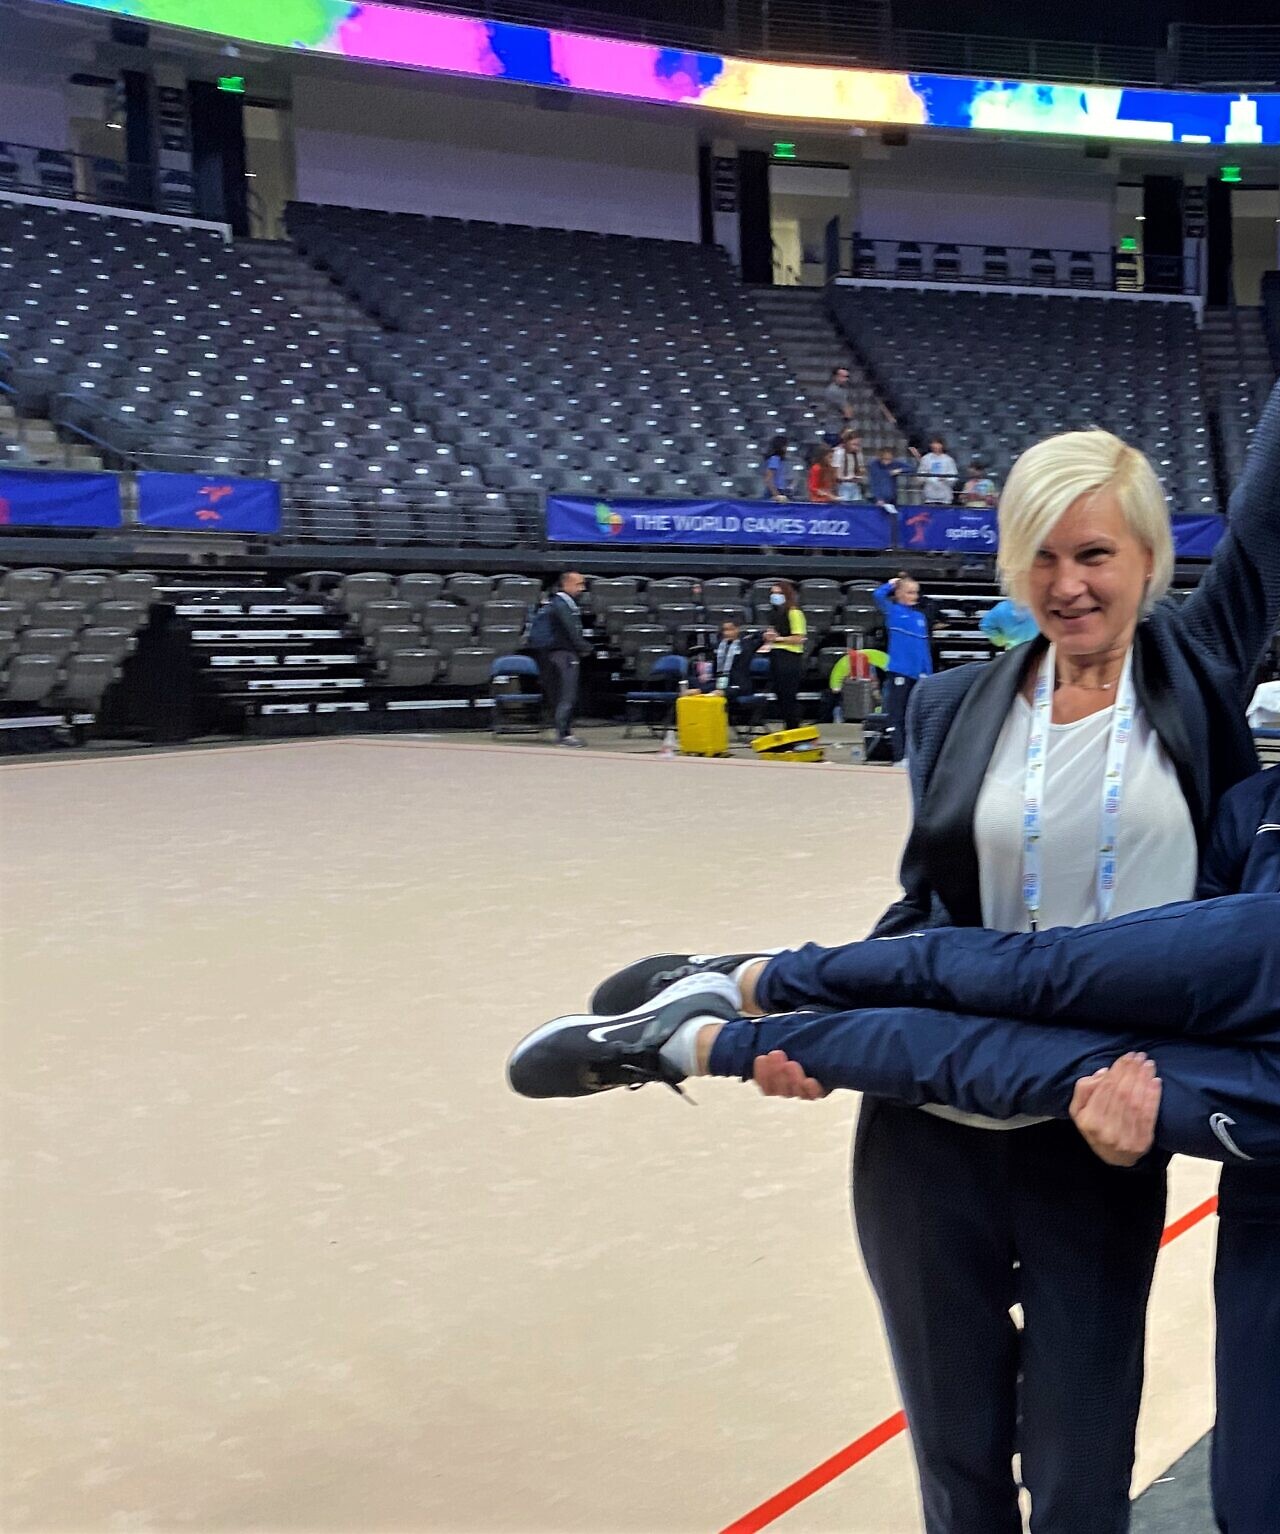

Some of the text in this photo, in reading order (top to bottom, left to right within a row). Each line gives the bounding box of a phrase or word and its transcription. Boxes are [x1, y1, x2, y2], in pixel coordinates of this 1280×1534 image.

[631, 515, 850, 536] THE WORLD GAMES 2022
